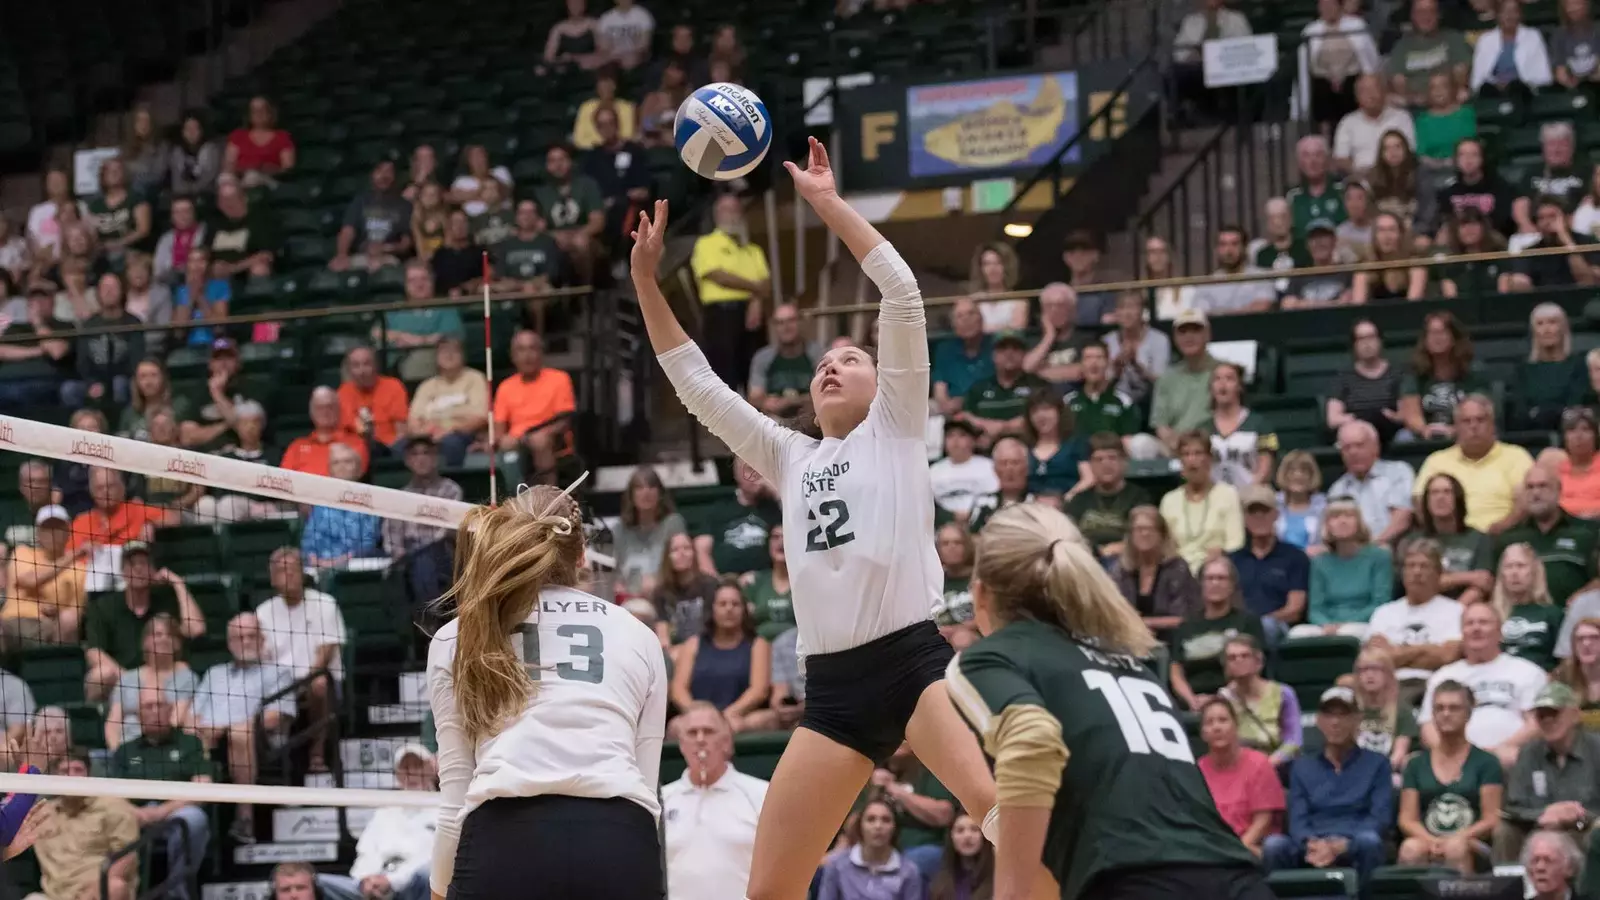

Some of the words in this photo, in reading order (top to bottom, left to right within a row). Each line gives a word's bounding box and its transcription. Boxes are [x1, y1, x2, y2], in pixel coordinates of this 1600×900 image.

[718, 85, 761, 124] molten
[712, 125, 735, 147] Touch
[861, 111, 898, 161] F
[71, 436, 114, 459] uchealth
[166, 455, 206, 477] uchealth
[805, 499, 856, 552] 22
[536, 601, 608, 615] LYER
[511, 623, 604, 684] 13
[1081, 669, 1195, 764] 16
